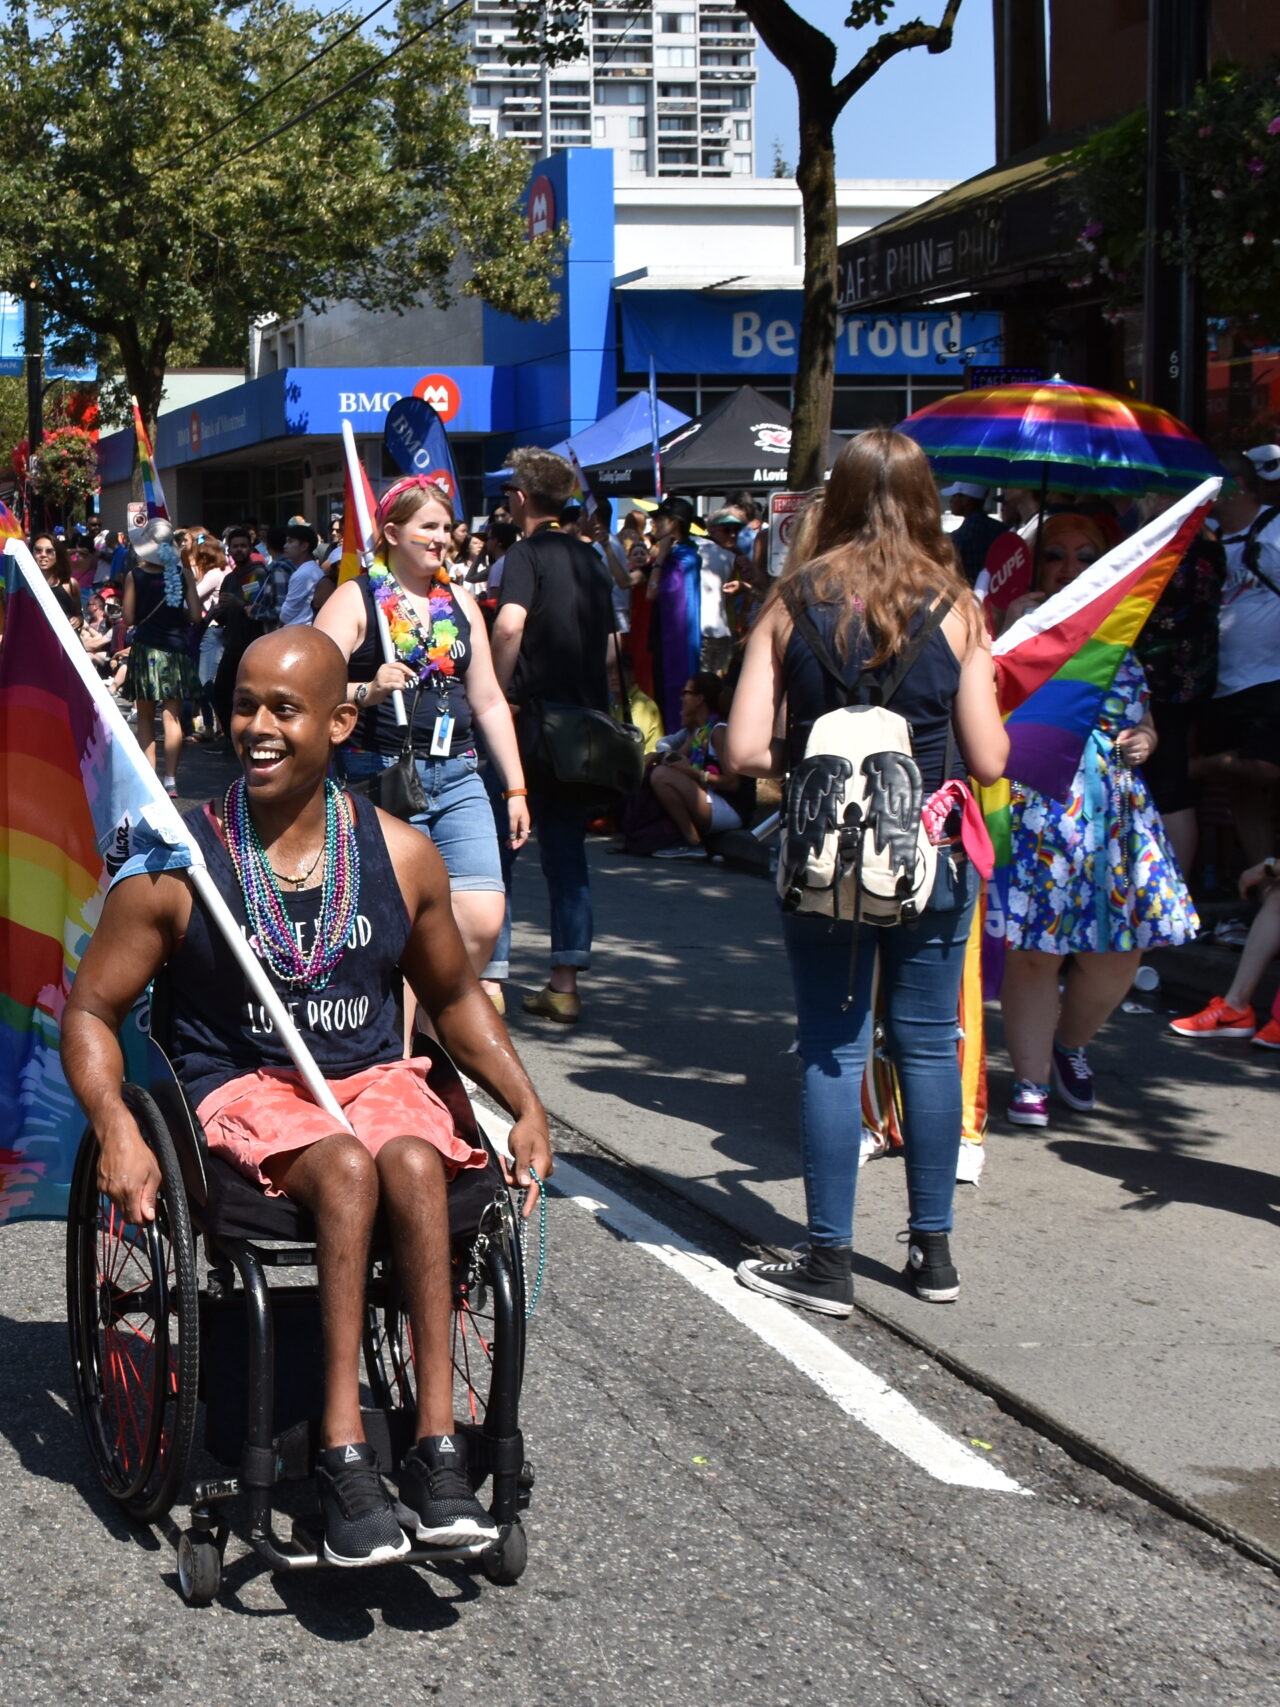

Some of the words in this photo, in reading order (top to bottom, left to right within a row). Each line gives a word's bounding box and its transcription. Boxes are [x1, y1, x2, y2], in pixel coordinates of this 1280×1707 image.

[886, 238, 933, 290] PHIN
[732, 311, 796, 358] Be
[338, 392, 402, 413] BMO
[392, 413, 430, 469] BMO
[753, 469, 762, 481] A
[989, 547, 1025, 594] CUPE
[307, 996, 369, 1032] PROUD
